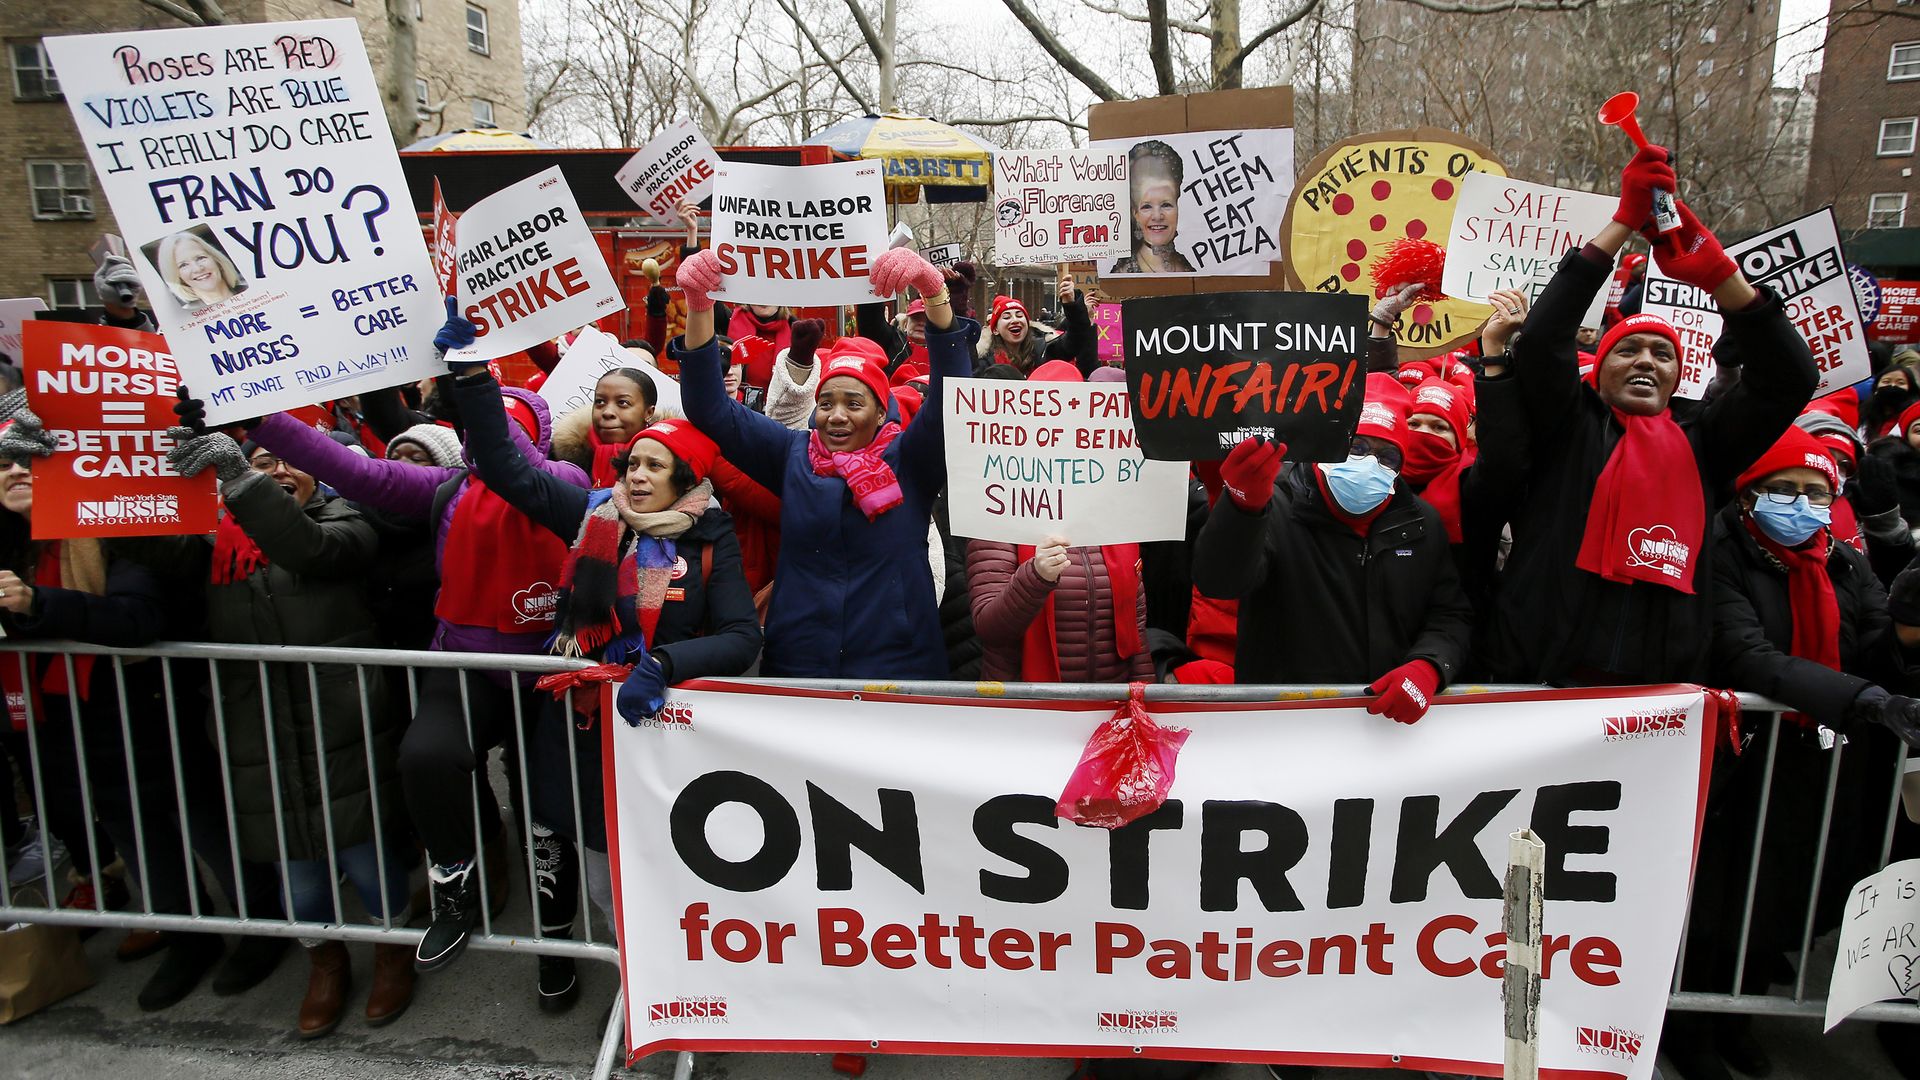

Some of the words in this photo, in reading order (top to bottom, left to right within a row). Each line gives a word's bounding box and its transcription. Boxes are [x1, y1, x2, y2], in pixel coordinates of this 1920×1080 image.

[224, 47, 274, 77] ARE
[275, 35, 336, 70] RED
[85, 90, 215, 129] VIOLETS
[227, 85, 279, 117] ARE
[281, 77, 350, 109] BLUE
[97, 141, 134, 174] I
[144, 128, 239, 170] REALLY
[243, 124, 292, 154] DO
[299, 111, 372, 147] CARE
[1193, 133, 1243, 174] LET
[630, 163, 660, 193] UNFAIR
[659, 134, 697, 167] LABOR
[645, 155, 693, 196] PRACTICE
[999, 155, 1063, 183] What
[1070, 154, 1127, 182] Would
[649, 158, 715, 217] STRIKE
[1183, 155, 1274, 206] THEM
[1303, 147, 1430, 212] PATIENTS
[149, 167, 276, 223] FRAN
[285, 167, 334, 197] DO
[719, 195, 783, 218] UNFAIR
[787, 195, 872, 218] LABOR
[1023, 187, 1115, 214] Florence
[1494, 188, 1571, 222] SAFE
[1203, 197, 1256, 233] EAT
[457, 240, 496, 277] NFAIR
[494, 206, 568, 252] LABOR
[734, 220, 845, 241] PRACTICE
[1019, 221, 1049, 247] do
[1460, 217, 1583, 256] STAFFIN
[716, 242, 871, 280] STRIKE
[931, 249, 947, 261] ON
[1191, 226, 1276, 268] PIZZA
[1743, 236, 1798, 277] ON
[466, 241, 552, 295] PRACTICE
[1764, 252, 1839, 299] RIKE
[332, 274, 418, 312] BETTER
[465, 257, 590, 338] STRIKE
[1467, 271, 1548, 308] LIVE
[1648, 281, 1718, 311] STRIK
[1881, 287, 1917, 296] MORE
[1882, 296, 1920, 305] URSES
[354, 306, 408, 336] CARE
[1672, 309, 1704, 329] FOR
[1785, 296, 1817, 321] OR
[1795, 305, 1845, 337] TER
[204, 312, 271, 343] MORE
[1135, 322, 1267, 357] MOUNT
[1274, 322, 1356, 355] SINAI
[1675, 326, 1713, 350] TTER
[1877, 322, 1911, 330] CARE
[62, 343, 176, 373] MORE
[211, 334, 300, 376] NURSES
[1814, 349, 1843, 373] RE
[38, 371, 185, 396] NURSE
[212, 387, 235, 406] MT
[241, 376, 285, 400] SINAI
[295, 364, 332, 386] FIND
[336, 359, 352, 376] A
[1682, 365, 1701, 384] RE
[955, 387, 1062, 417] NURSES
[1089, 392, 1130, 418] PAT
[1139, 360, 1357, 420] UNFAIR!
[55, 430, 181, 452] BETTE
[967, 422, 1028, 447] TIRED
[1035, 427, 1064, 448] OF
[73, 456, 181, 477] CARE
[984, 454, 1104, 484] MOUNTED
[1118, 458, 1146, 482] BY
[78, 501, 178, 518] NURSES
[984, 483, 1064, 520] SINAI
[78, 516, 181, 525] ASSOCIATION
[650, 706, 693, 726] RSES
[1602, 714, 1687, 736] NURSES
[1603, 729, 1686, 743] ASSOCIATION
[670, 770, 926, 896] ON
[972, 780, 1622, 912] STRIKE
[1854, 885, 1879, 920] It
[1897, 878, 1916, 899] is
[679, 901, 797, 965] for
[818, 907, 1072, 972] Better
[1095, 921, 1394, 982] Patient
[1847, 937, 1871, 970] WE
[1882, 922, 1917, 951] AR
[648, 1001, 728, 1021] NURSES
[648, 1017, 729, 1027] ASSOCIATION
[1098, 1013, 1177, 1029] NURSES
[1098, 1026, 1178, 1034] ASSOCIATION
[1577, 1026, 1641, 1056] NURS
[1609, 1025, 1628, 1035] New
[1577, 1045, 1634, 1062] ASSOCIA
